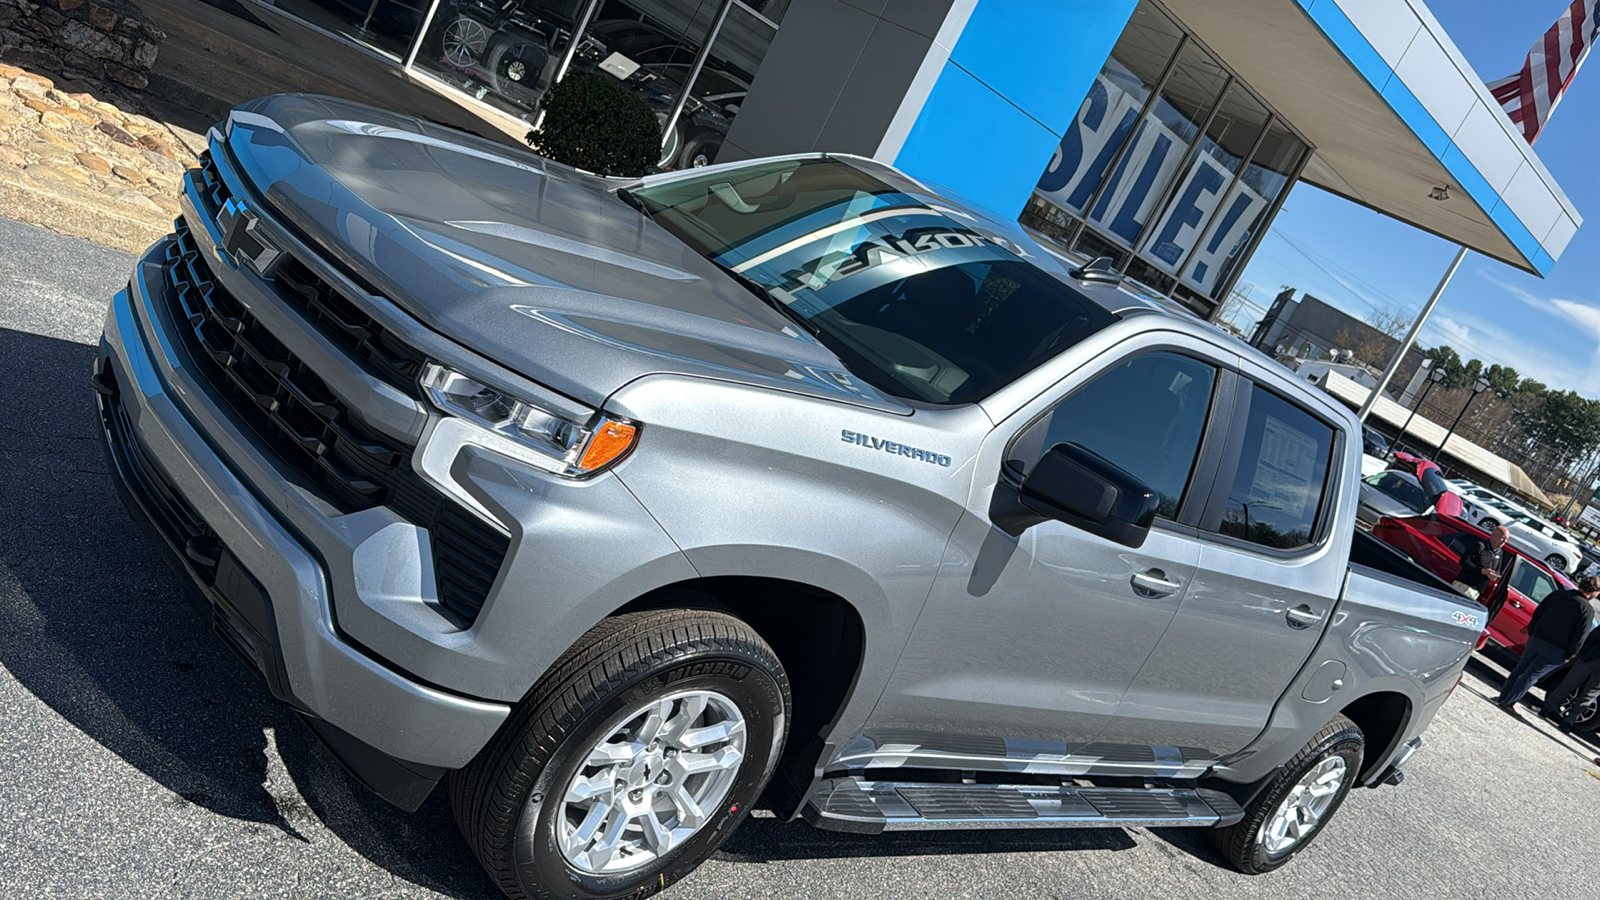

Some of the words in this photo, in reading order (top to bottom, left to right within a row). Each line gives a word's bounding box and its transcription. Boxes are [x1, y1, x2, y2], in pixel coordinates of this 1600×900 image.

[1037, 78, 1254, 285] SALE!
[841, 429, 952, 467] SILVERADO
[667, 662, 750, 685] MICHELIN
